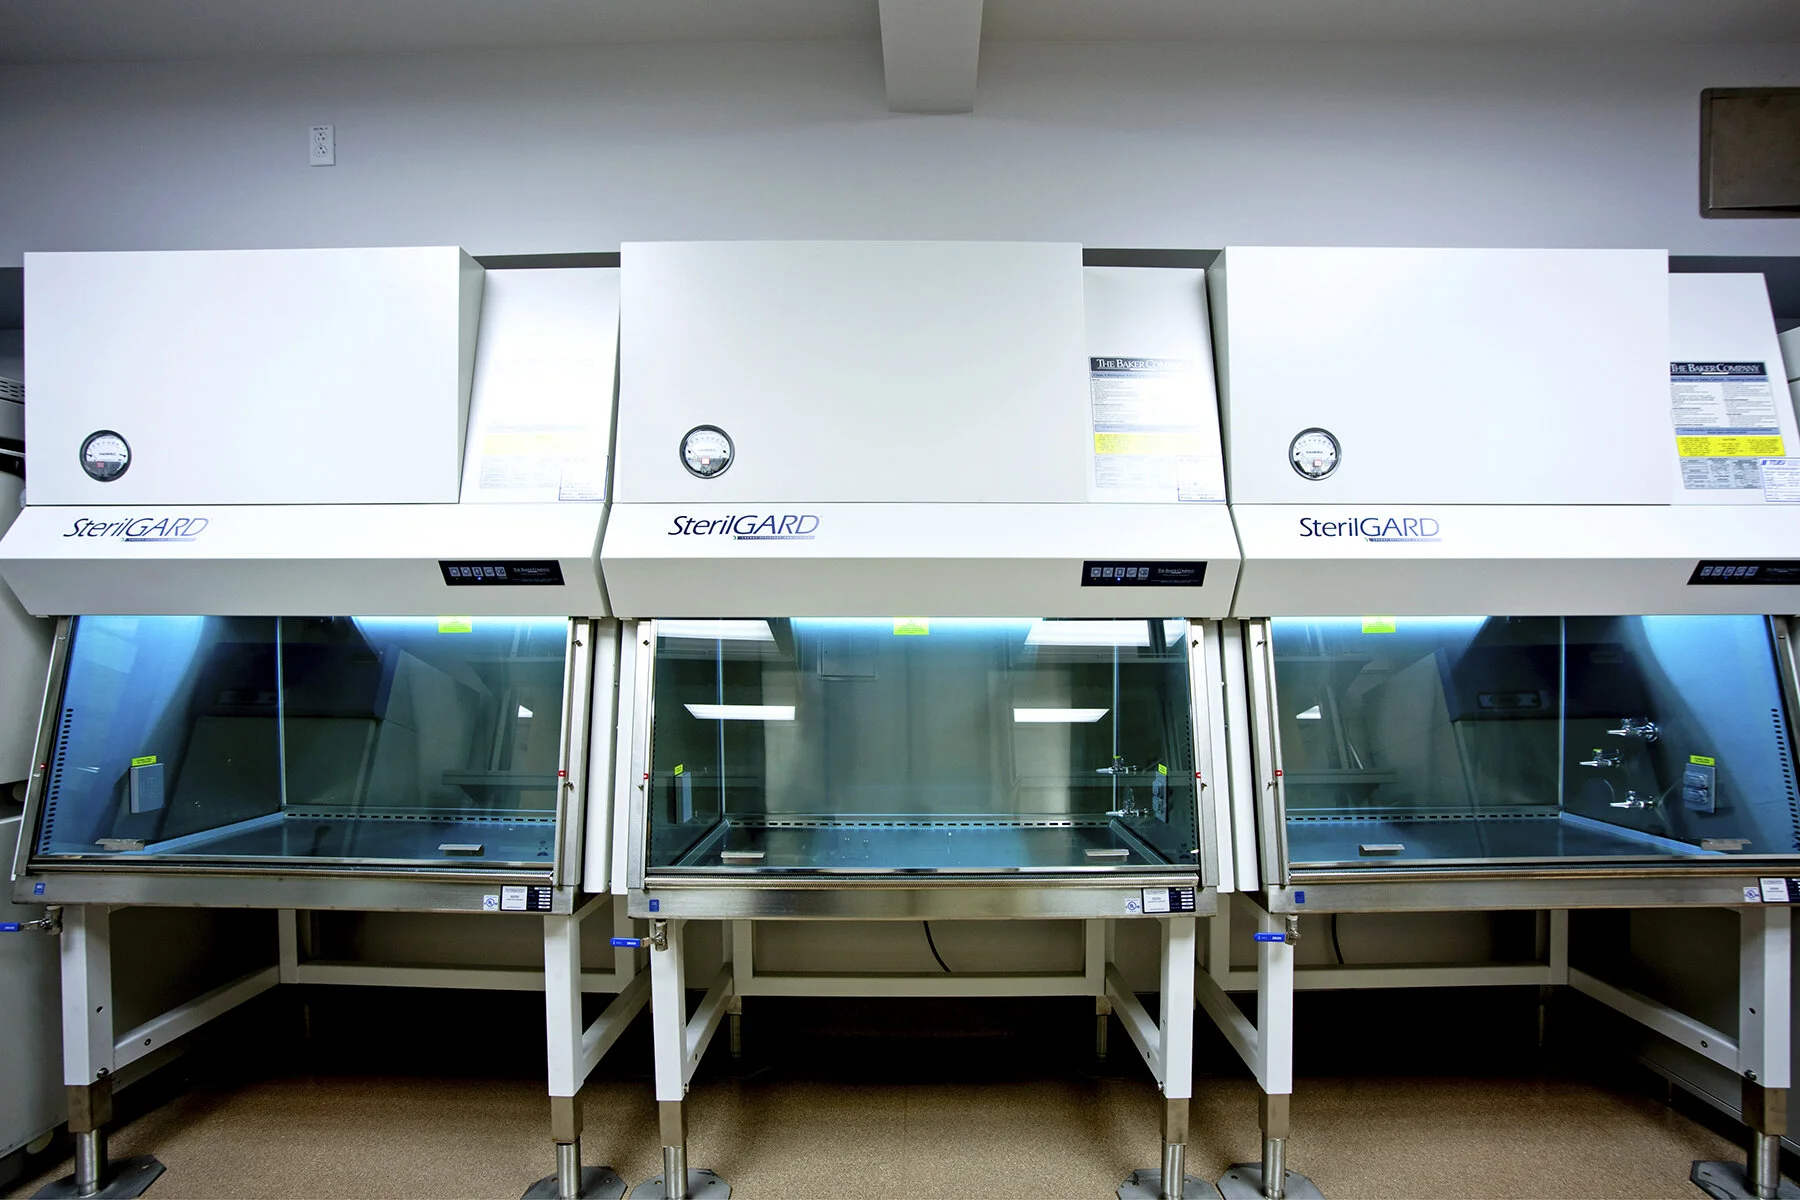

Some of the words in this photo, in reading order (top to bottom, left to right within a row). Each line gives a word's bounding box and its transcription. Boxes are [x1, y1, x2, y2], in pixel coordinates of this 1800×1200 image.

[1096, 359, 1115, 368] THE
[1116, 359, 1145, 368] BAKER
[1687, 363, 1716, 372] BAKER
[1716, 363, 1760, 372] COMPANY
[63, 518, 209, 537] SterilGARD
[668, 515, 820, 535] SterilGARD
[1300, 517, 1440, 537] SterilGARD
